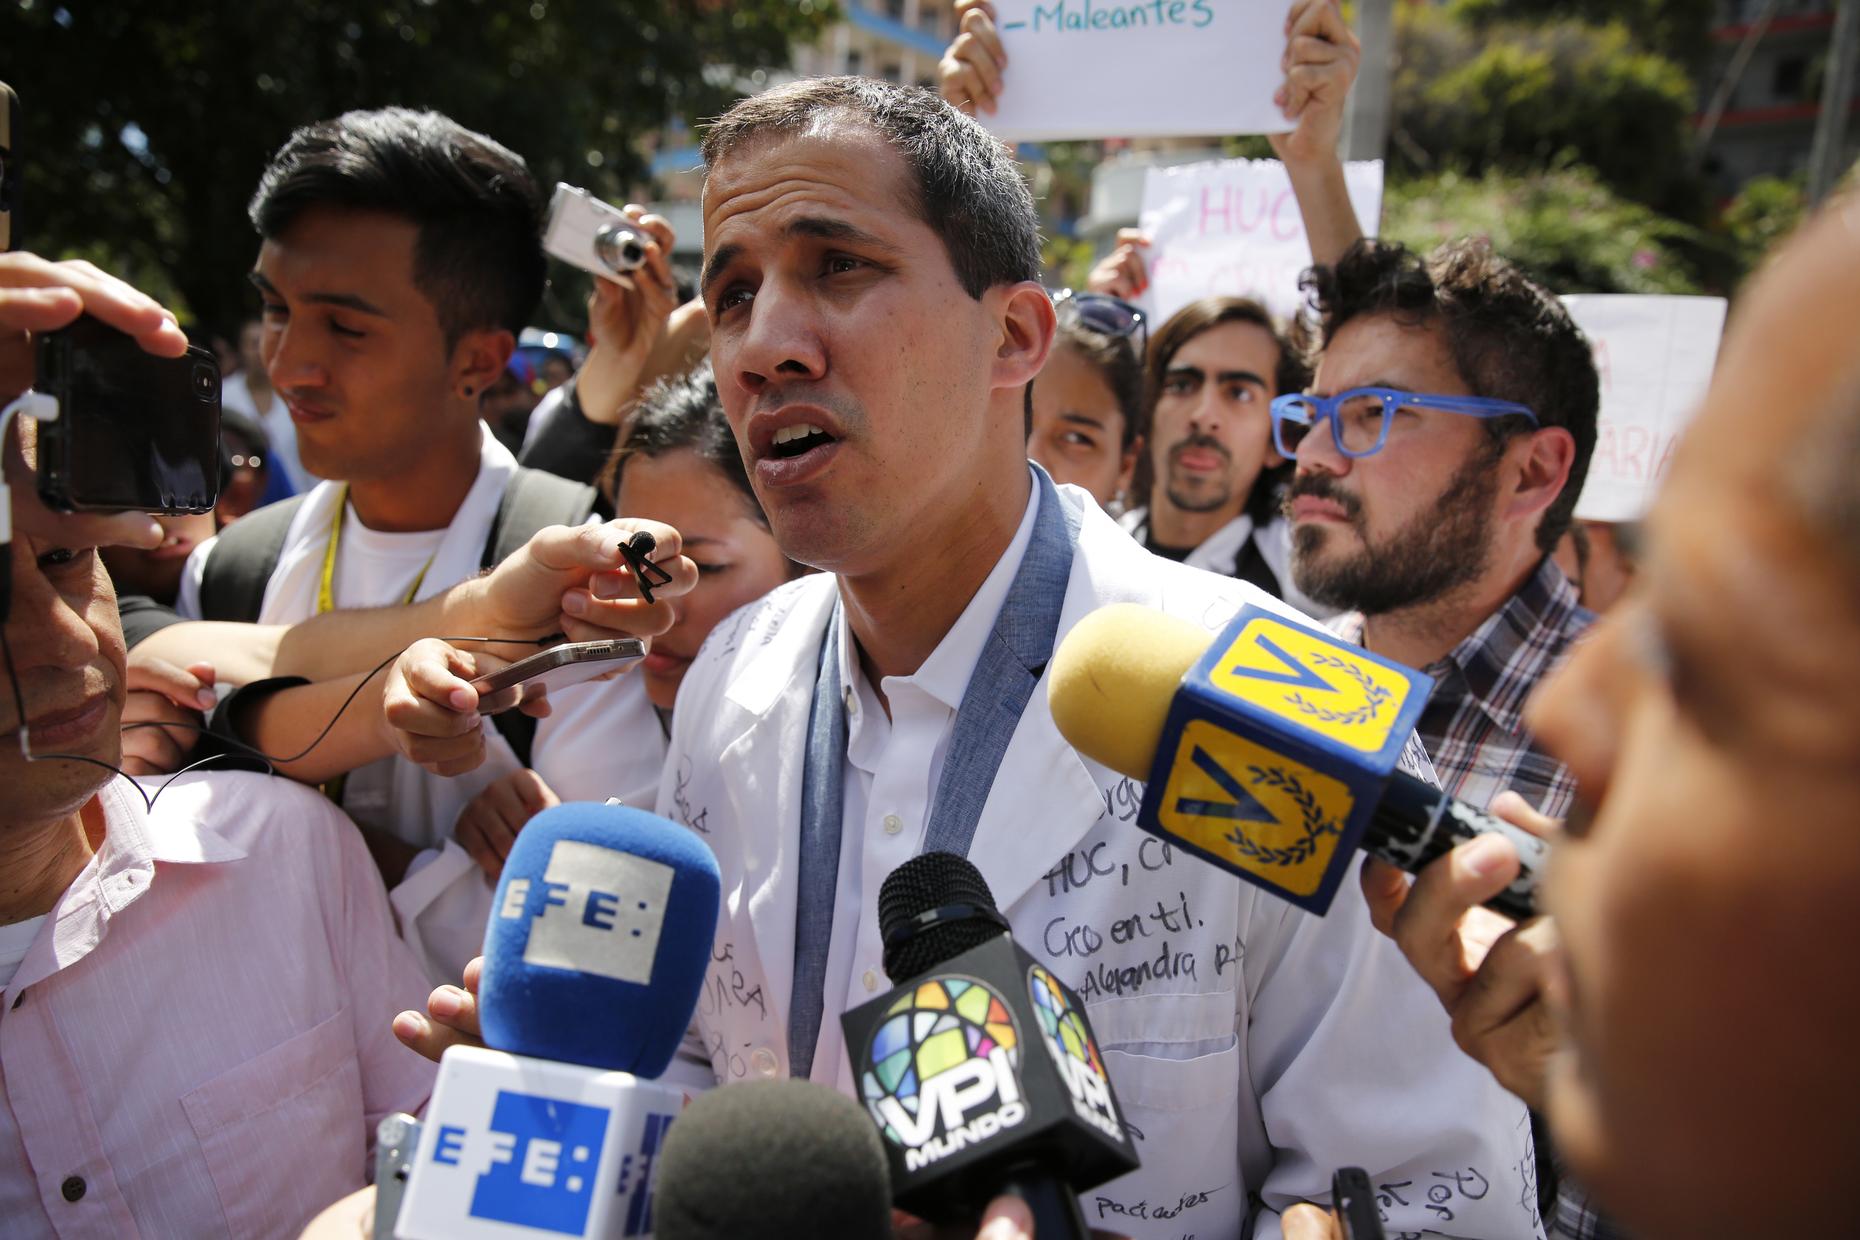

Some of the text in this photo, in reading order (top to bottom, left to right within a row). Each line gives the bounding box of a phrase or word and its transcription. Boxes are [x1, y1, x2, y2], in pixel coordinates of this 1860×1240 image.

[1200, 183, 1298, 241] HUC
[877, 1045, 1020, 1147] VPI
[904, 1100, 1026, 1172] MUNDO
